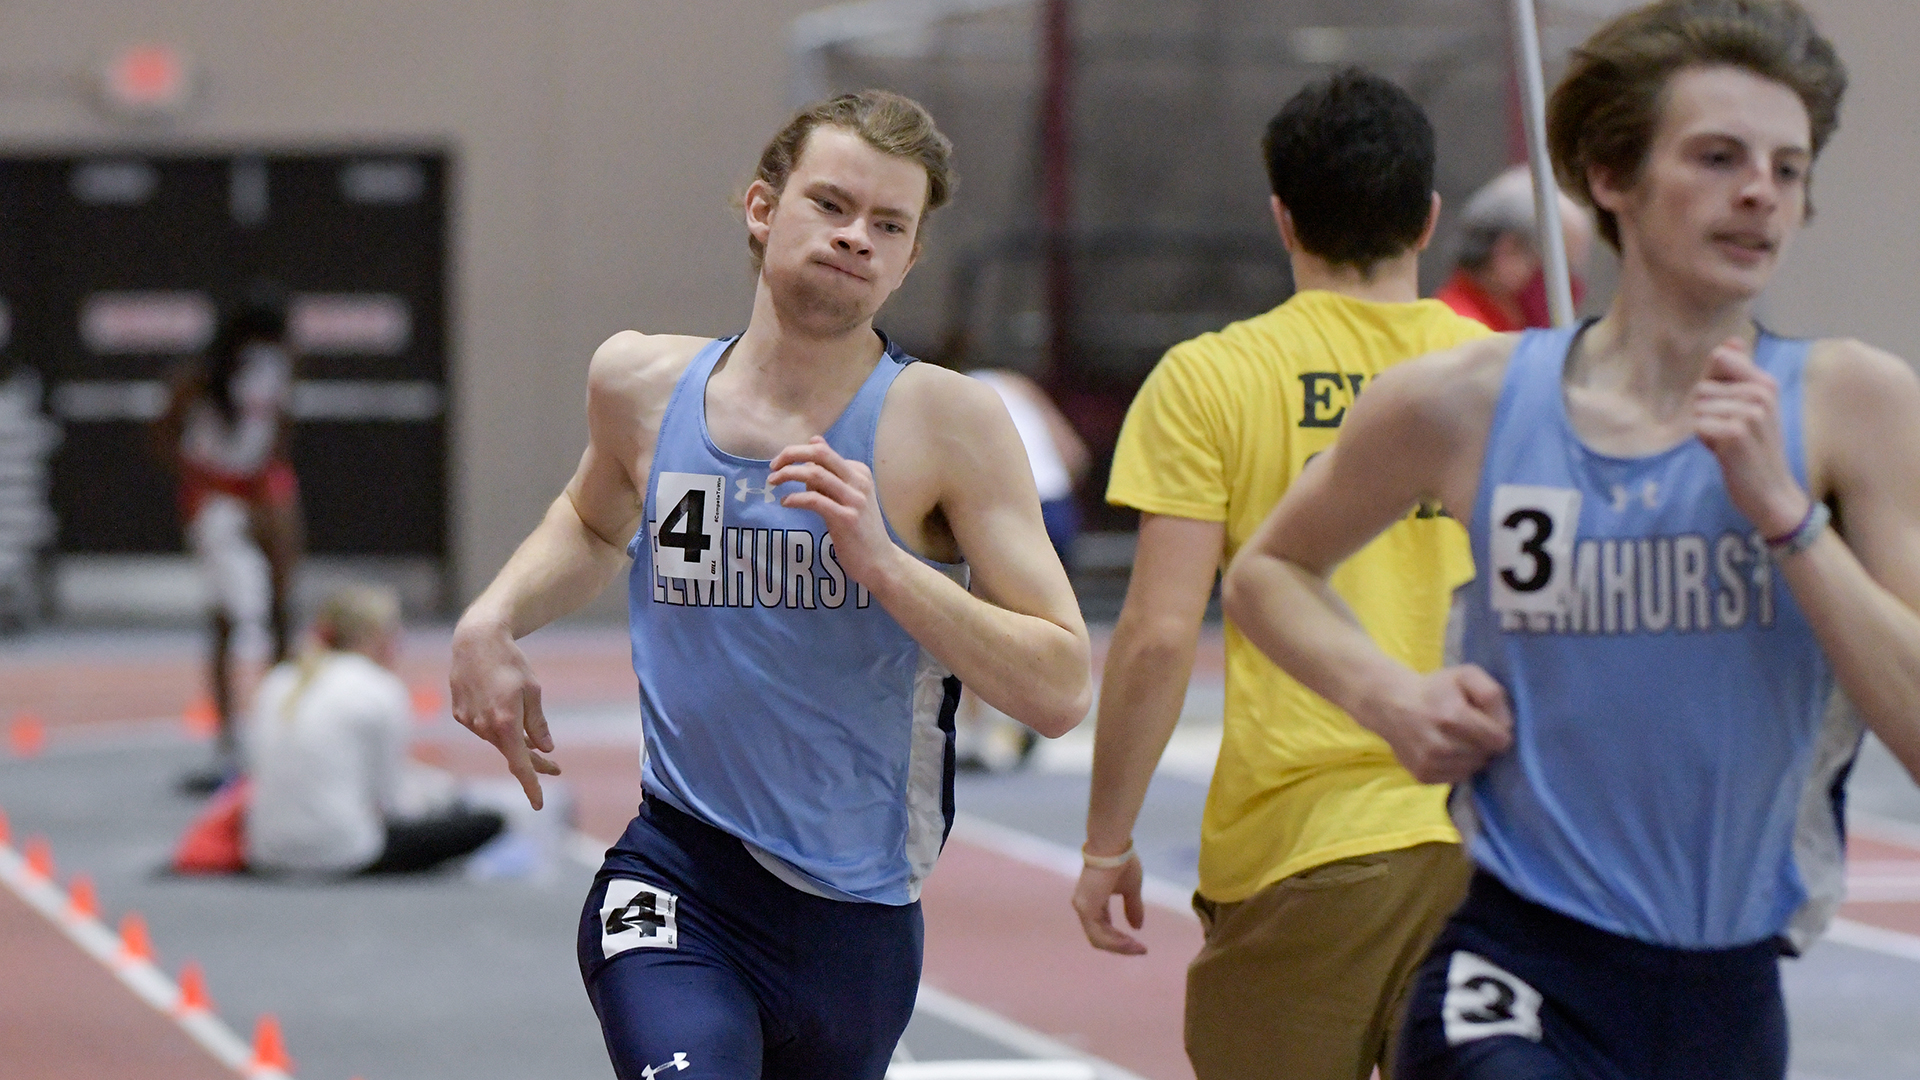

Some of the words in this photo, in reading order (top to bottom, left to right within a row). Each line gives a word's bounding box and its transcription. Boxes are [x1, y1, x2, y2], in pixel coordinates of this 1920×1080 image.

[659, 489, 711, 563] 4
[1500, 509, 1553, 592] 3
[606, 891, 666, 938] 4
